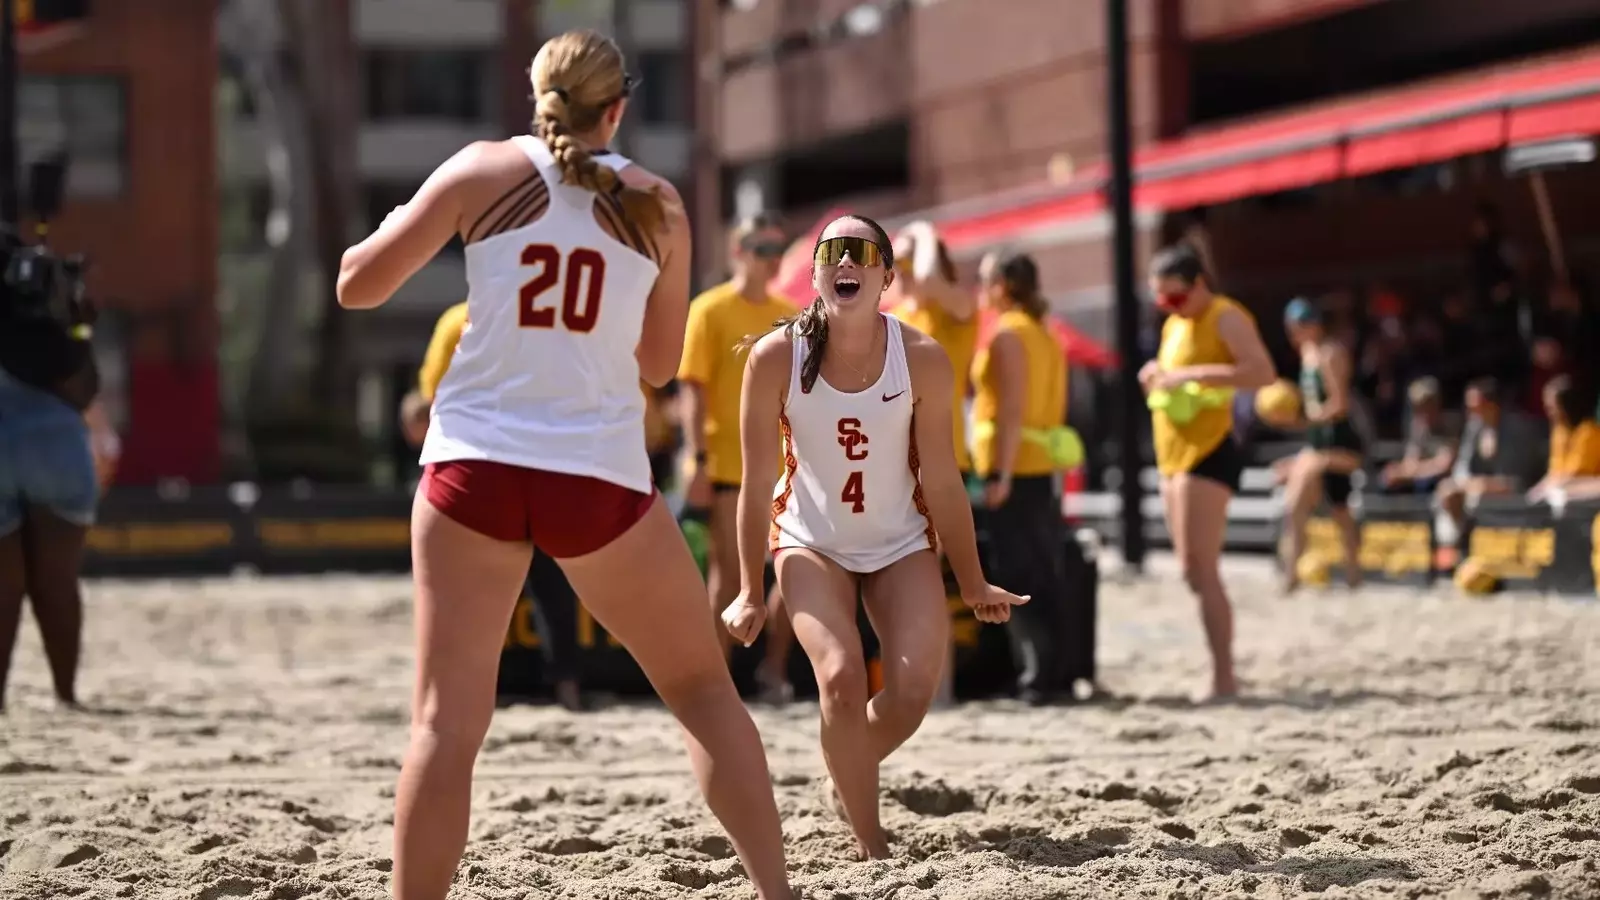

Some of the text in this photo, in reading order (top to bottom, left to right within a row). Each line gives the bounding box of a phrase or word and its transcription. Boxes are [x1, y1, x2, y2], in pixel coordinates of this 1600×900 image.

[518, 243, 606, 334] 20
[837, 417, 869, 461] SC
[841, 471, 865, 514] 4
